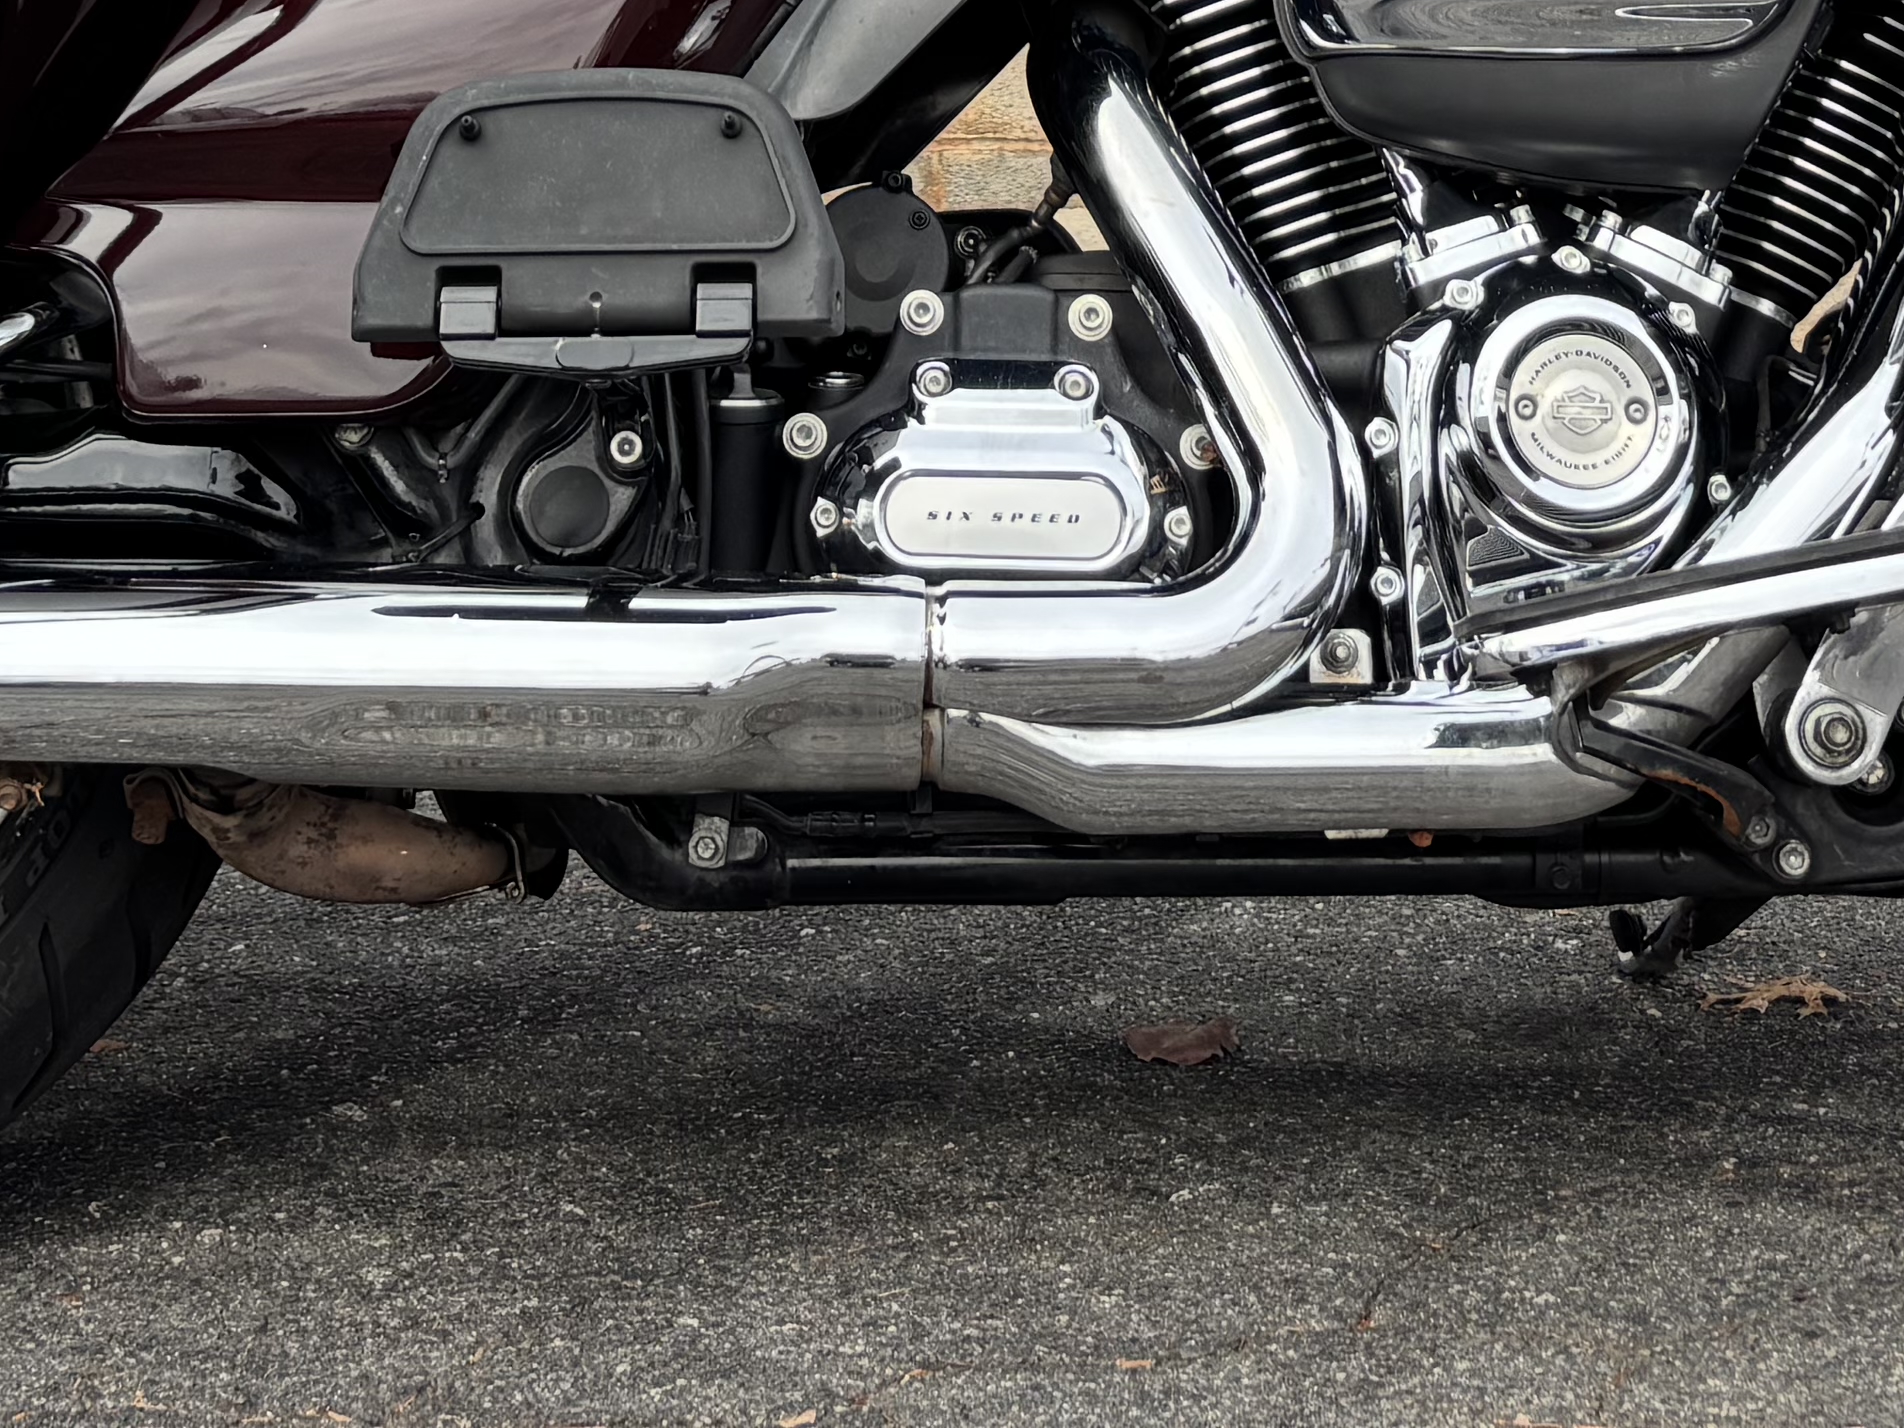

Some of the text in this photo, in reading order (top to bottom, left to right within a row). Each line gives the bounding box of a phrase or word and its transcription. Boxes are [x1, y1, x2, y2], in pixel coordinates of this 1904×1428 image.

[1528, 348, 1633, 390] HARLEY-DAVIDSON
[926, 509, 1082, 525] SIX SPEED
